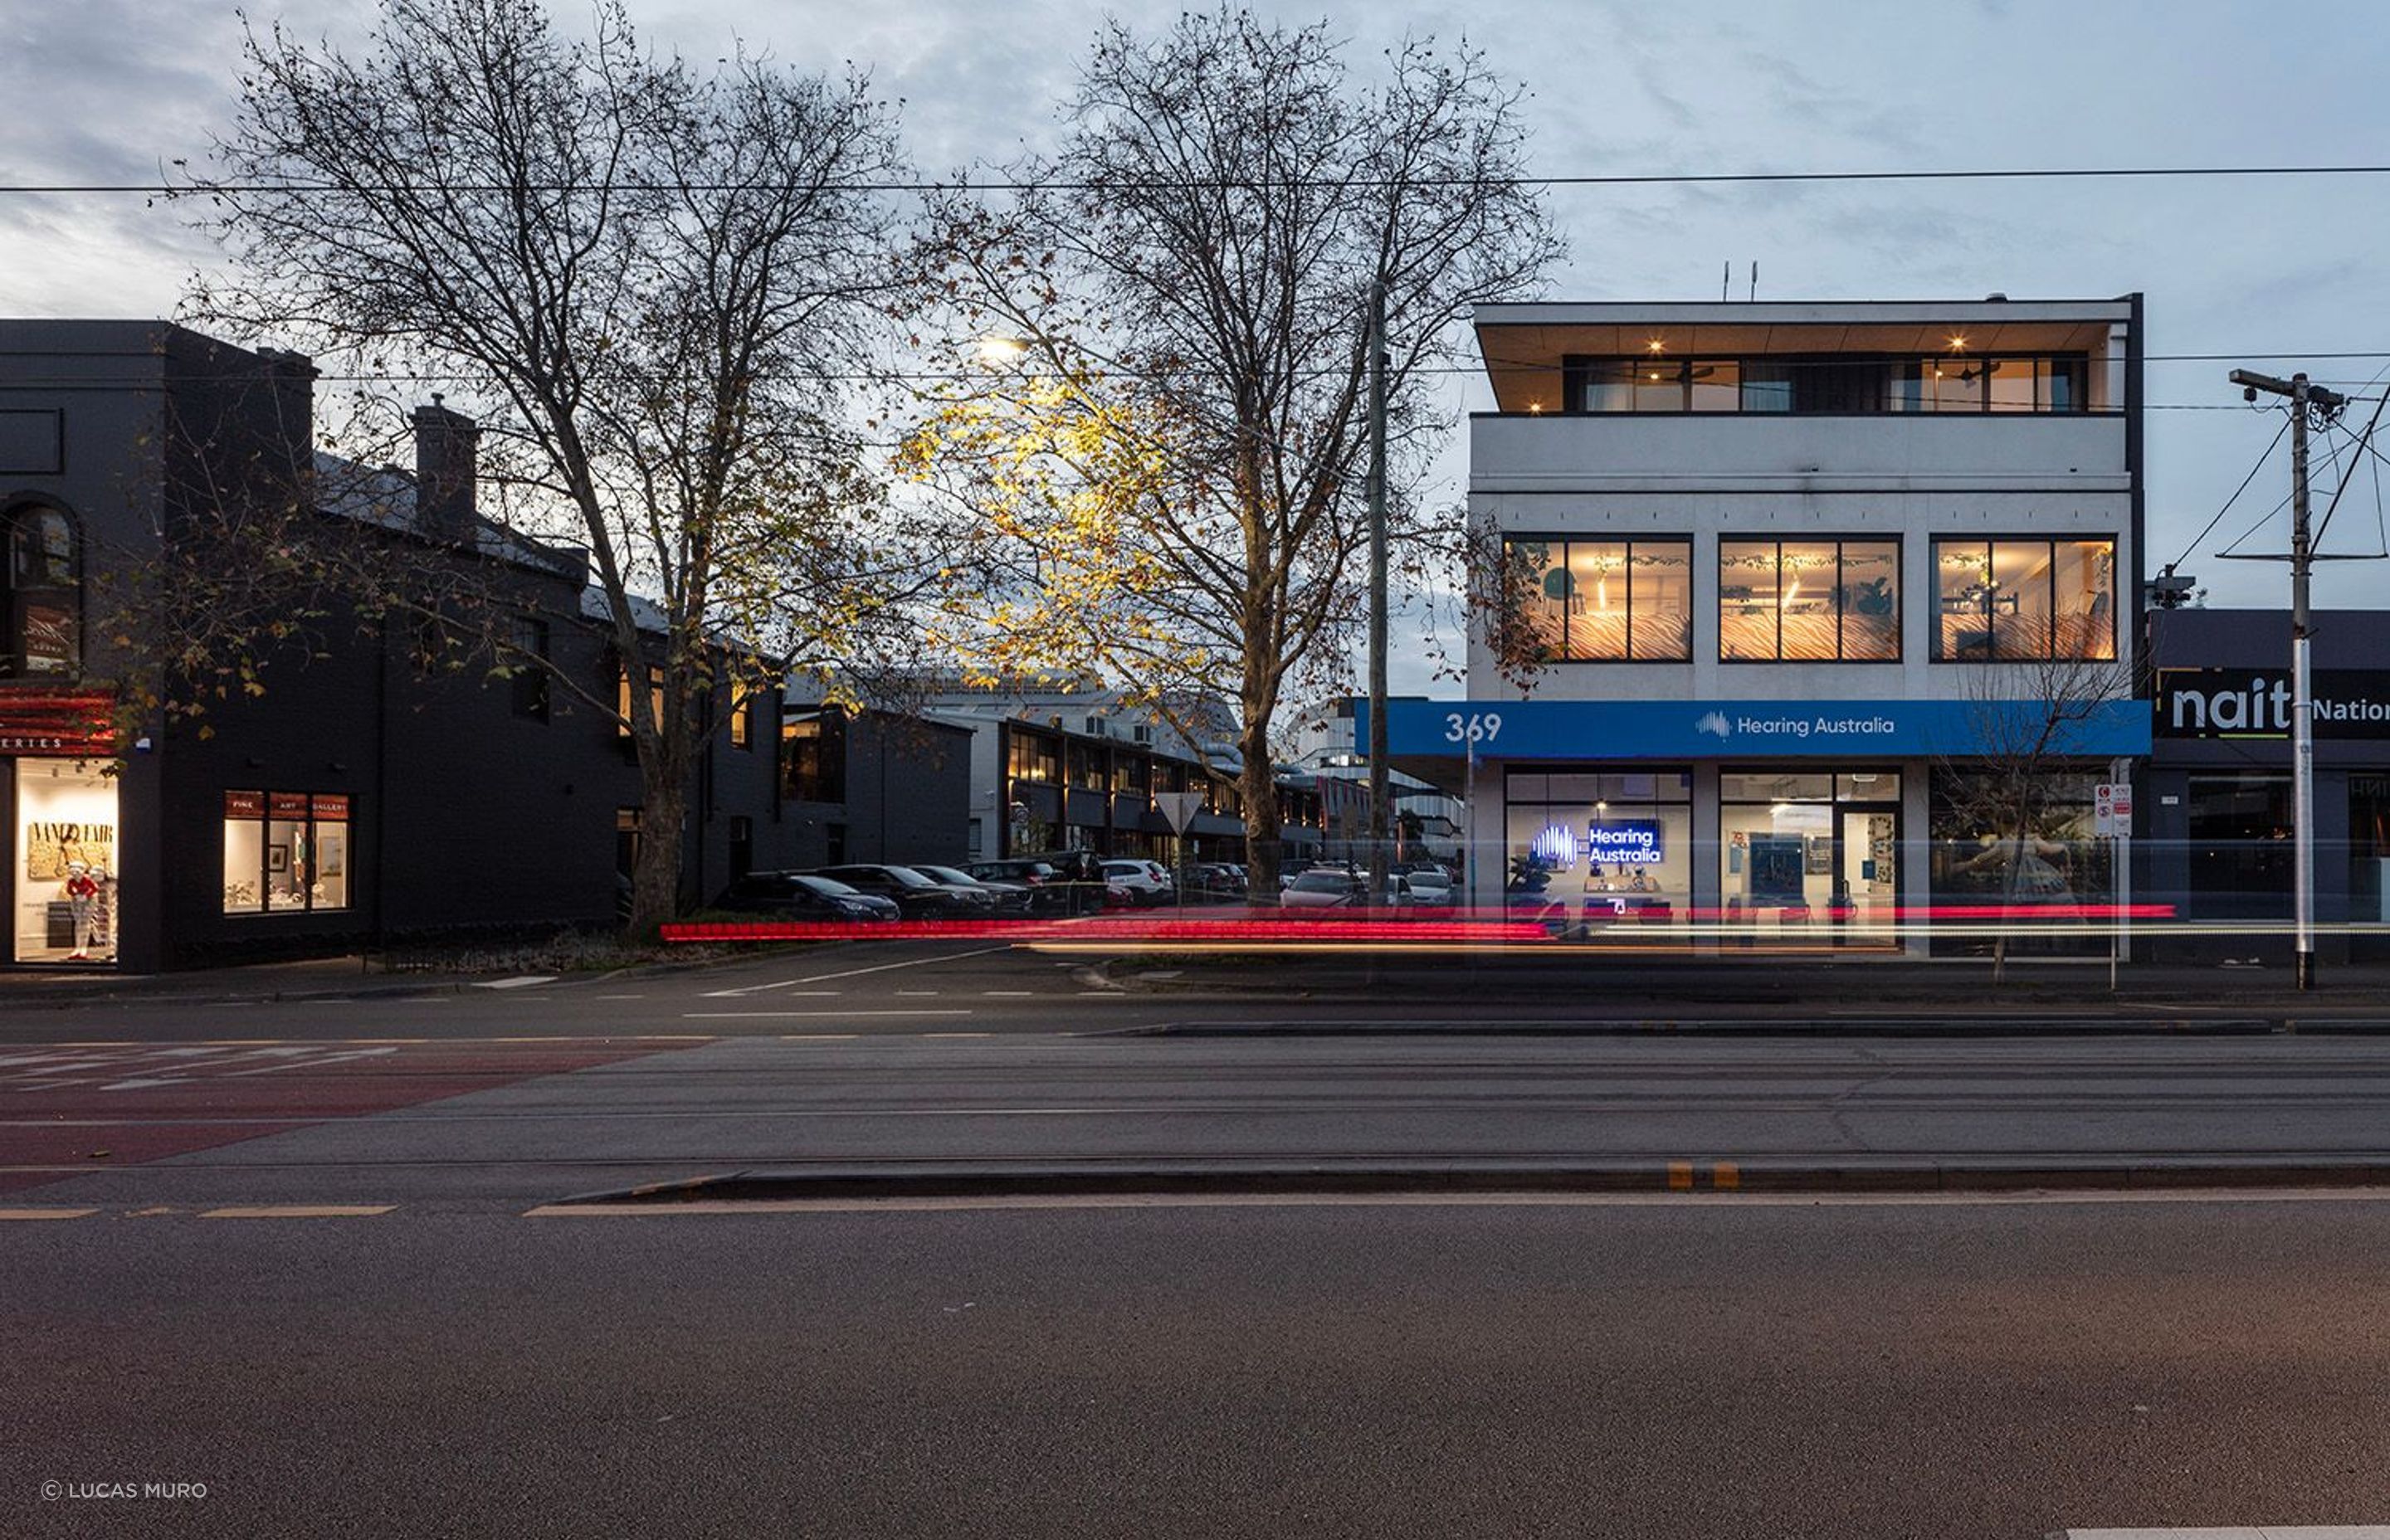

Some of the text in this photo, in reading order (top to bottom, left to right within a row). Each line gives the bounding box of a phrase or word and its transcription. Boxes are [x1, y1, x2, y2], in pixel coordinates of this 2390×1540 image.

[2173, 677, 2291, 729] nait
[1445, 714, 1502, 742] 369
[1738, 717, 1895, 738] Hearing Australia
[1, 738, 61, 748] ERIES
[1590, 829, 1653, 846] Hearing
[1590, 848, 1661, 863] Australia
